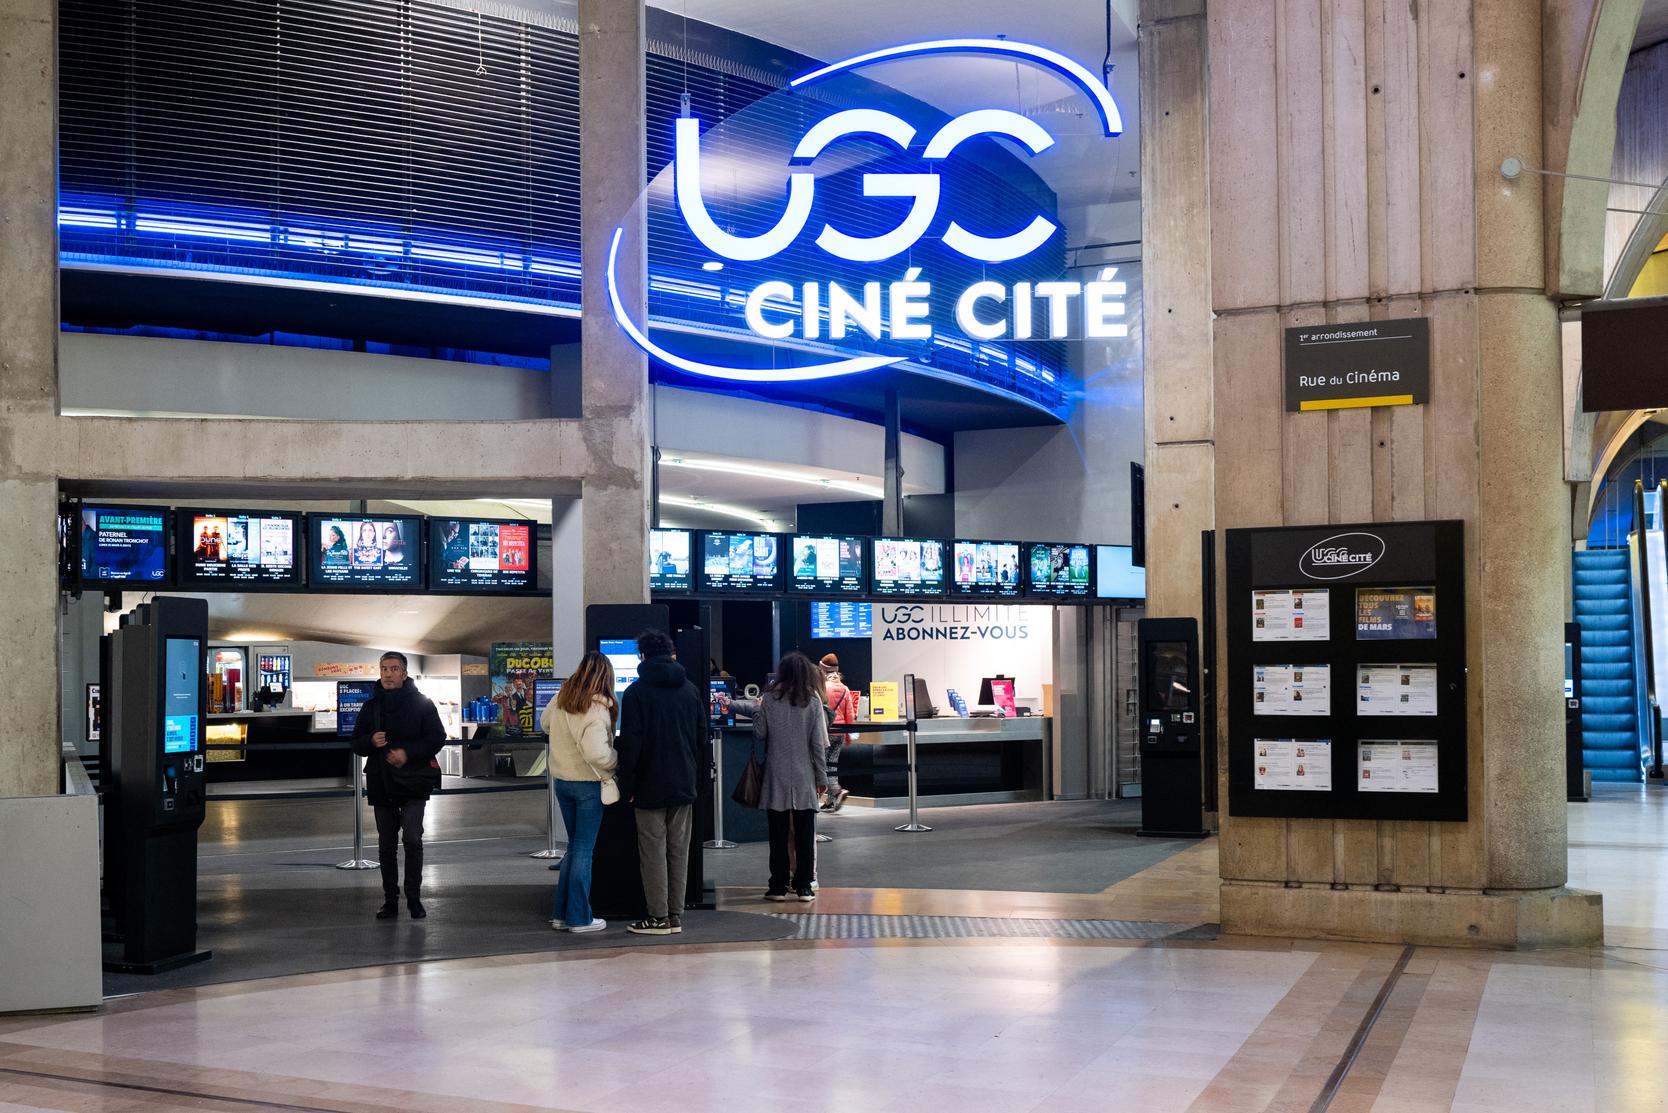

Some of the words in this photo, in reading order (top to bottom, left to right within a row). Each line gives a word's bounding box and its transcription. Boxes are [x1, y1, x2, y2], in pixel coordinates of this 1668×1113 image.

[676, 108, 1057, 263] UGC
[746, 267, 932, 341] CINÉ
[956, 267, 1128, 340] CITÉ
[1311, 328, 1378, 341] arrondissement
[1300, 375, 1326, 387] Rue
[1330, 375, 1343, 385] du
[1346, 369, 1400, 384] Cinéma
[99, 515, 163, 525] AVANT-PREMIÈRE
[1311, 547, 1348, 563] UGC
[1324, 554, 1349, 563] CINÉ
[1349, 552, 1373, 562] CITÉ
[881, 605, 925, 624] UGC
[882, 625, 1029, 641] ABONNEZ-VOUS
[1369, 623, 1393, 631] MARS
